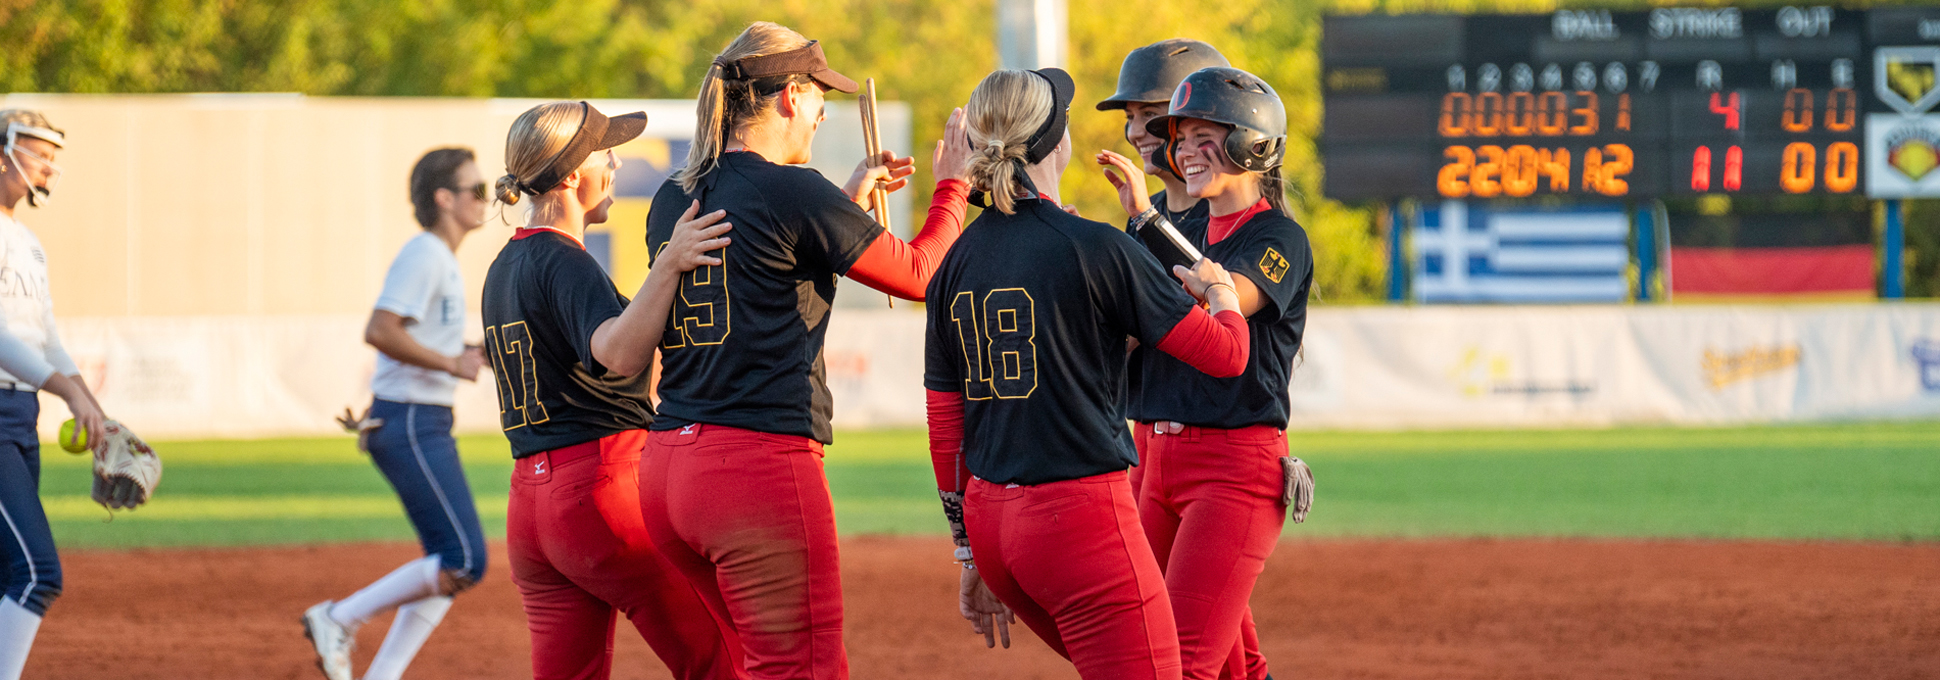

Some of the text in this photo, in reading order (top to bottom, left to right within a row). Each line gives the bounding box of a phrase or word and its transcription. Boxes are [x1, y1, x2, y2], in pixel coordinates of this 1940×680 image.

[1649, 7, 1743, 39] STRIKE
[1776, 6, 1835, 37] OUT
[1709, 92, 1740, 130] 4
[486, 320, 550, 432] 17
[950, 287, 1038, 401] 18
